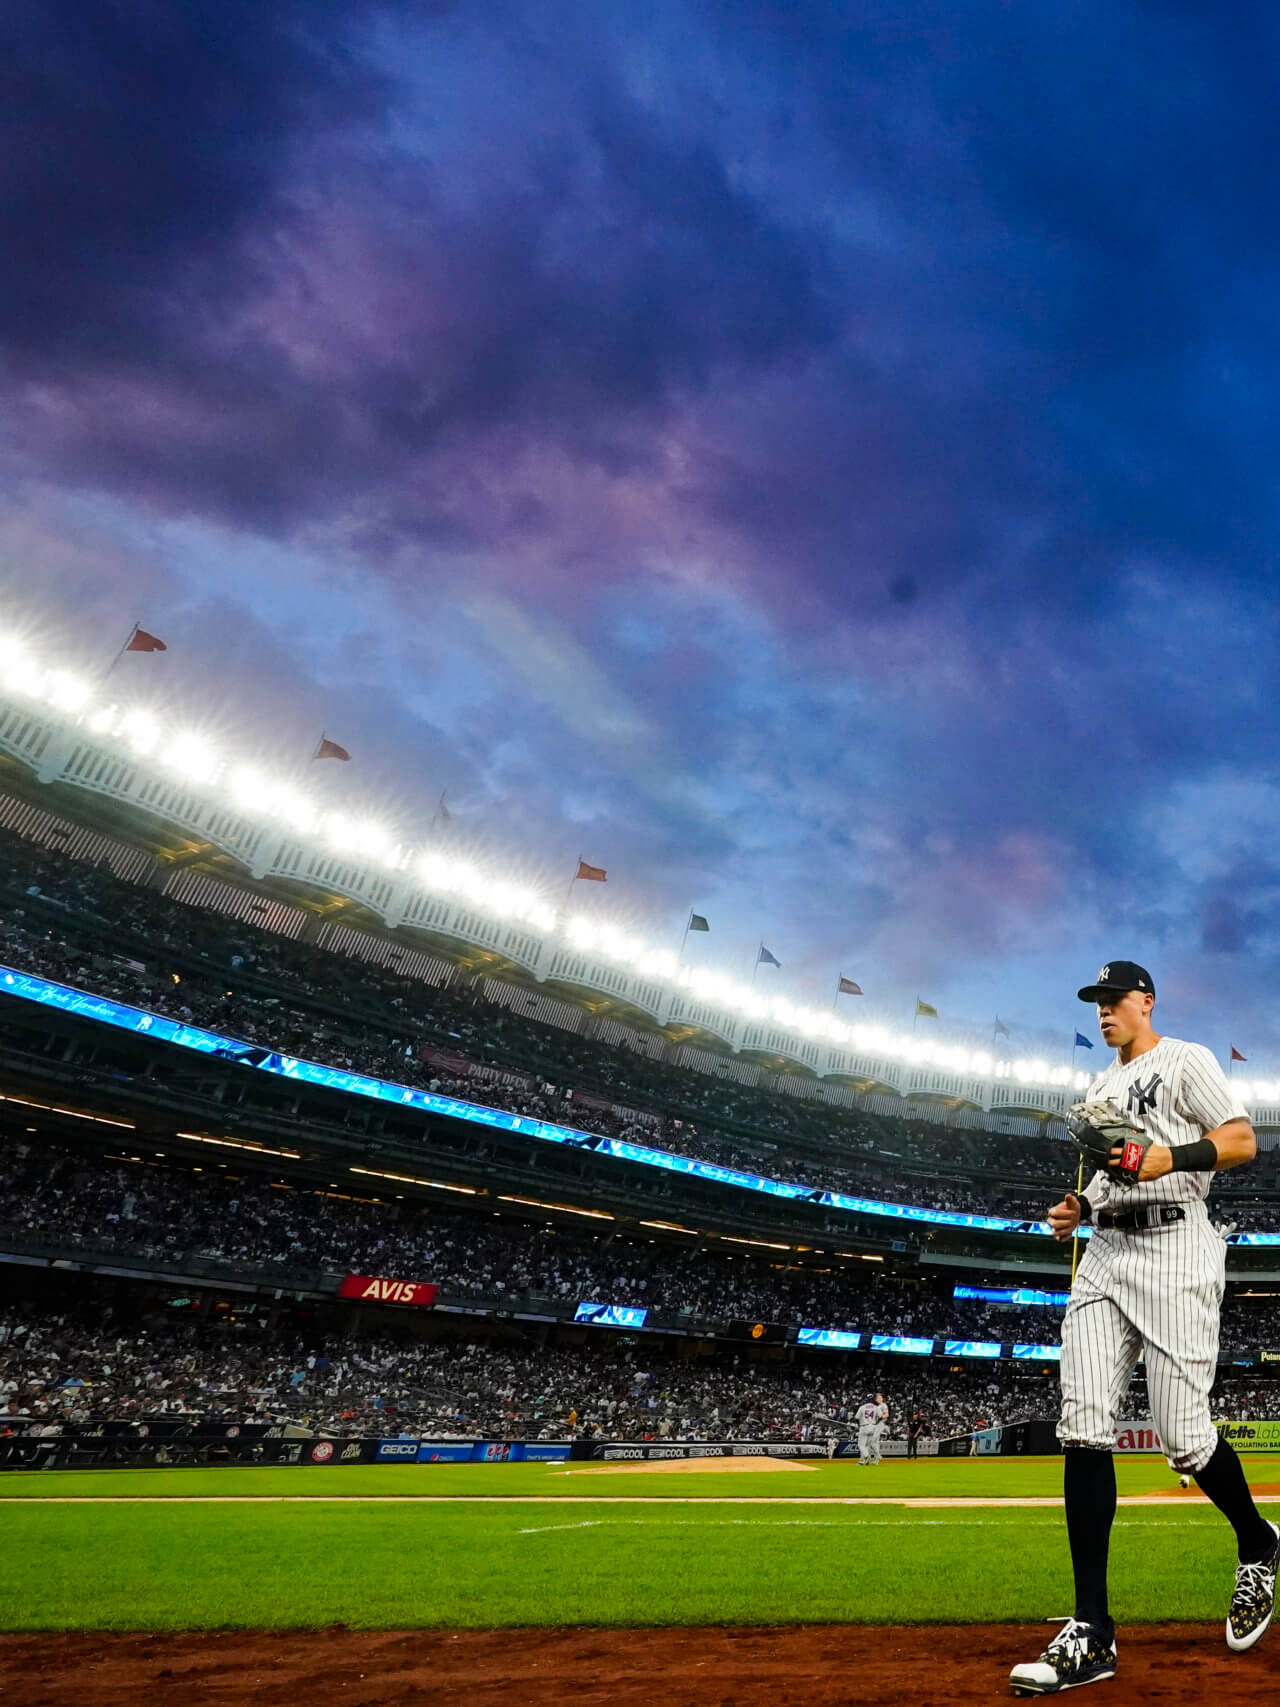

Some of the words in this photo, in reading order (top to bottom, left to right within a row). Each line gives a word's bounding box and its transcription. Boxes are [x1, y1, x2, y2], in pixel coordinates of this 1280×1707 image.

[468, 1063, 502, 1081] PARTY
[502, 1074, 528, 1089] DECK
[1166, 1209, 1178, 1219] 99
[361, 1280, 417, 1302] AVIS
[864, 1410, 875, 1419] 54
[380, 1443, 418, 1455] GEICO
[623, 1449, 645, 1459] COOL
[665, 1448, 686, 1458] COOL
[705, 1447, 725, 1456] COOL
[748, 1446, 766, 1455] COOL
[781, 1446, 798, 1454] COOL
